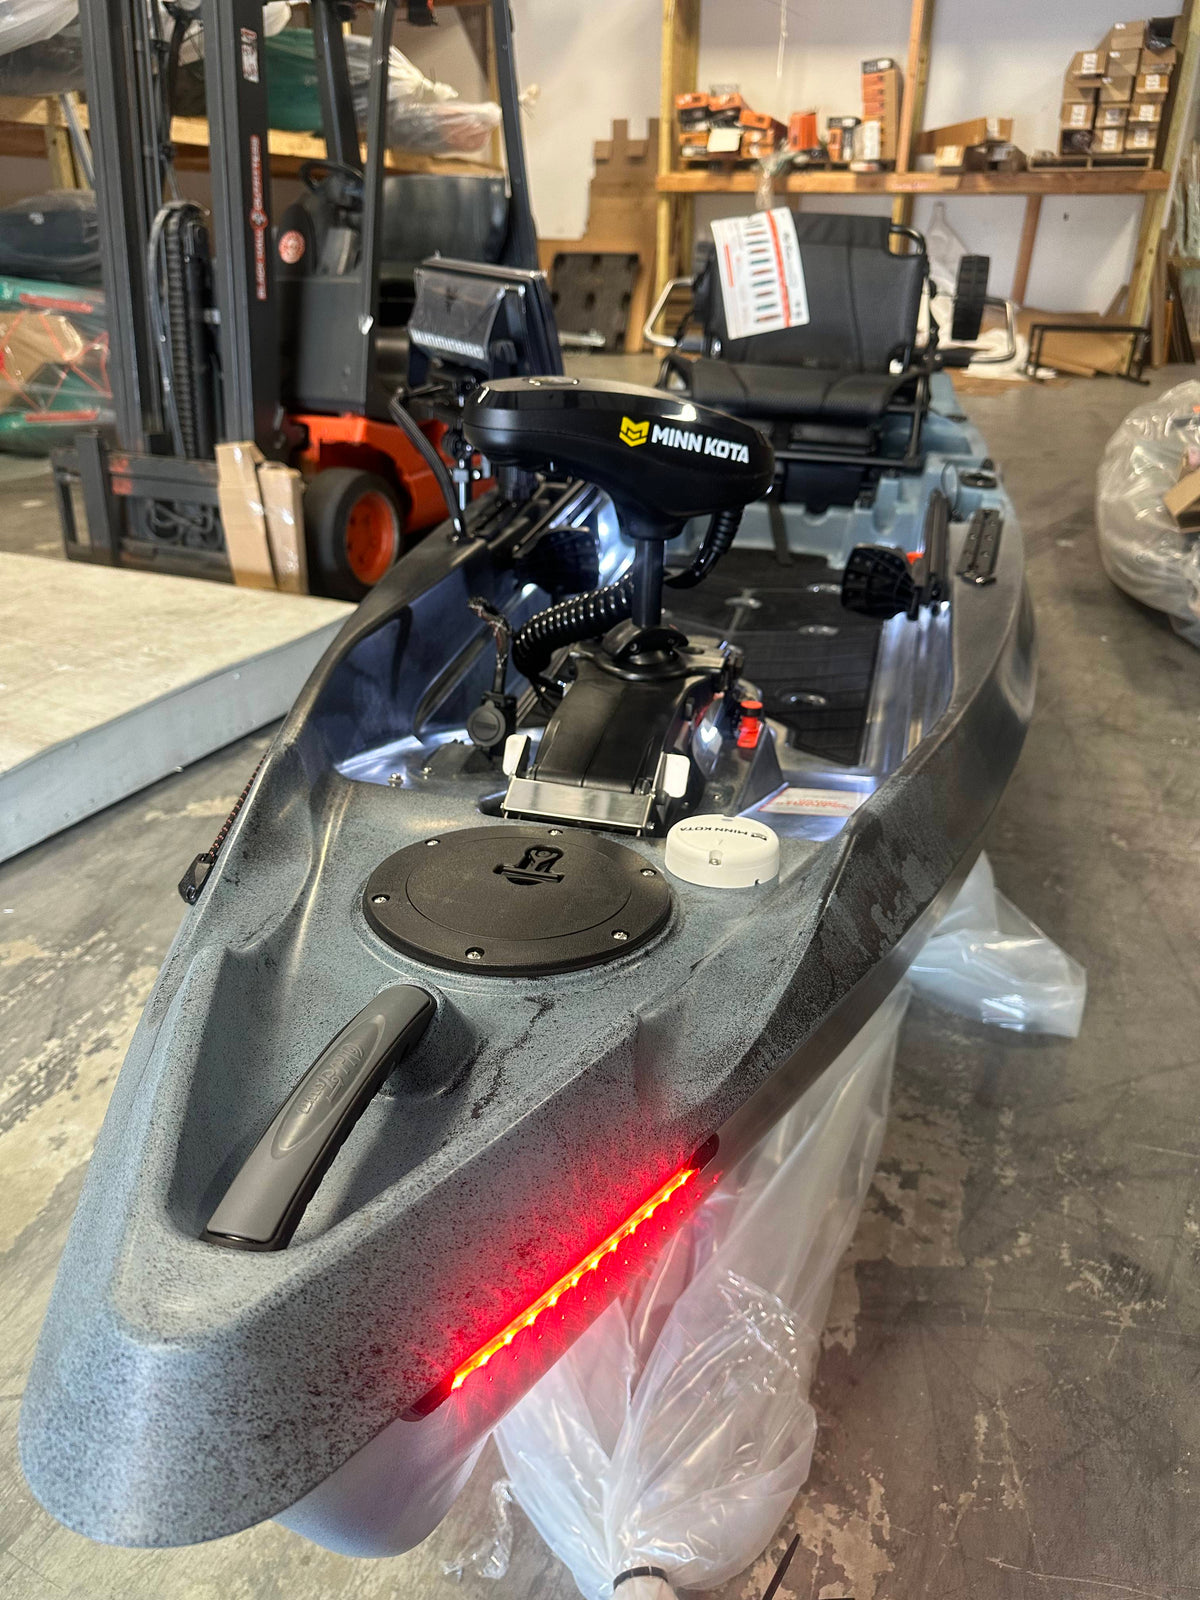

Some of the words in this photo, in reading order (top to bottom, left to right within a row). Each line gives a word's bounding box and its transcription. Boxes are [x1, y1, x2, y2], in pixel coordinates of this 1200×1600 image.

[651, 424, 703, 453] MINN
[704, 436, 749, 464] KOTA
[714, 826, 748, 836] MINN
